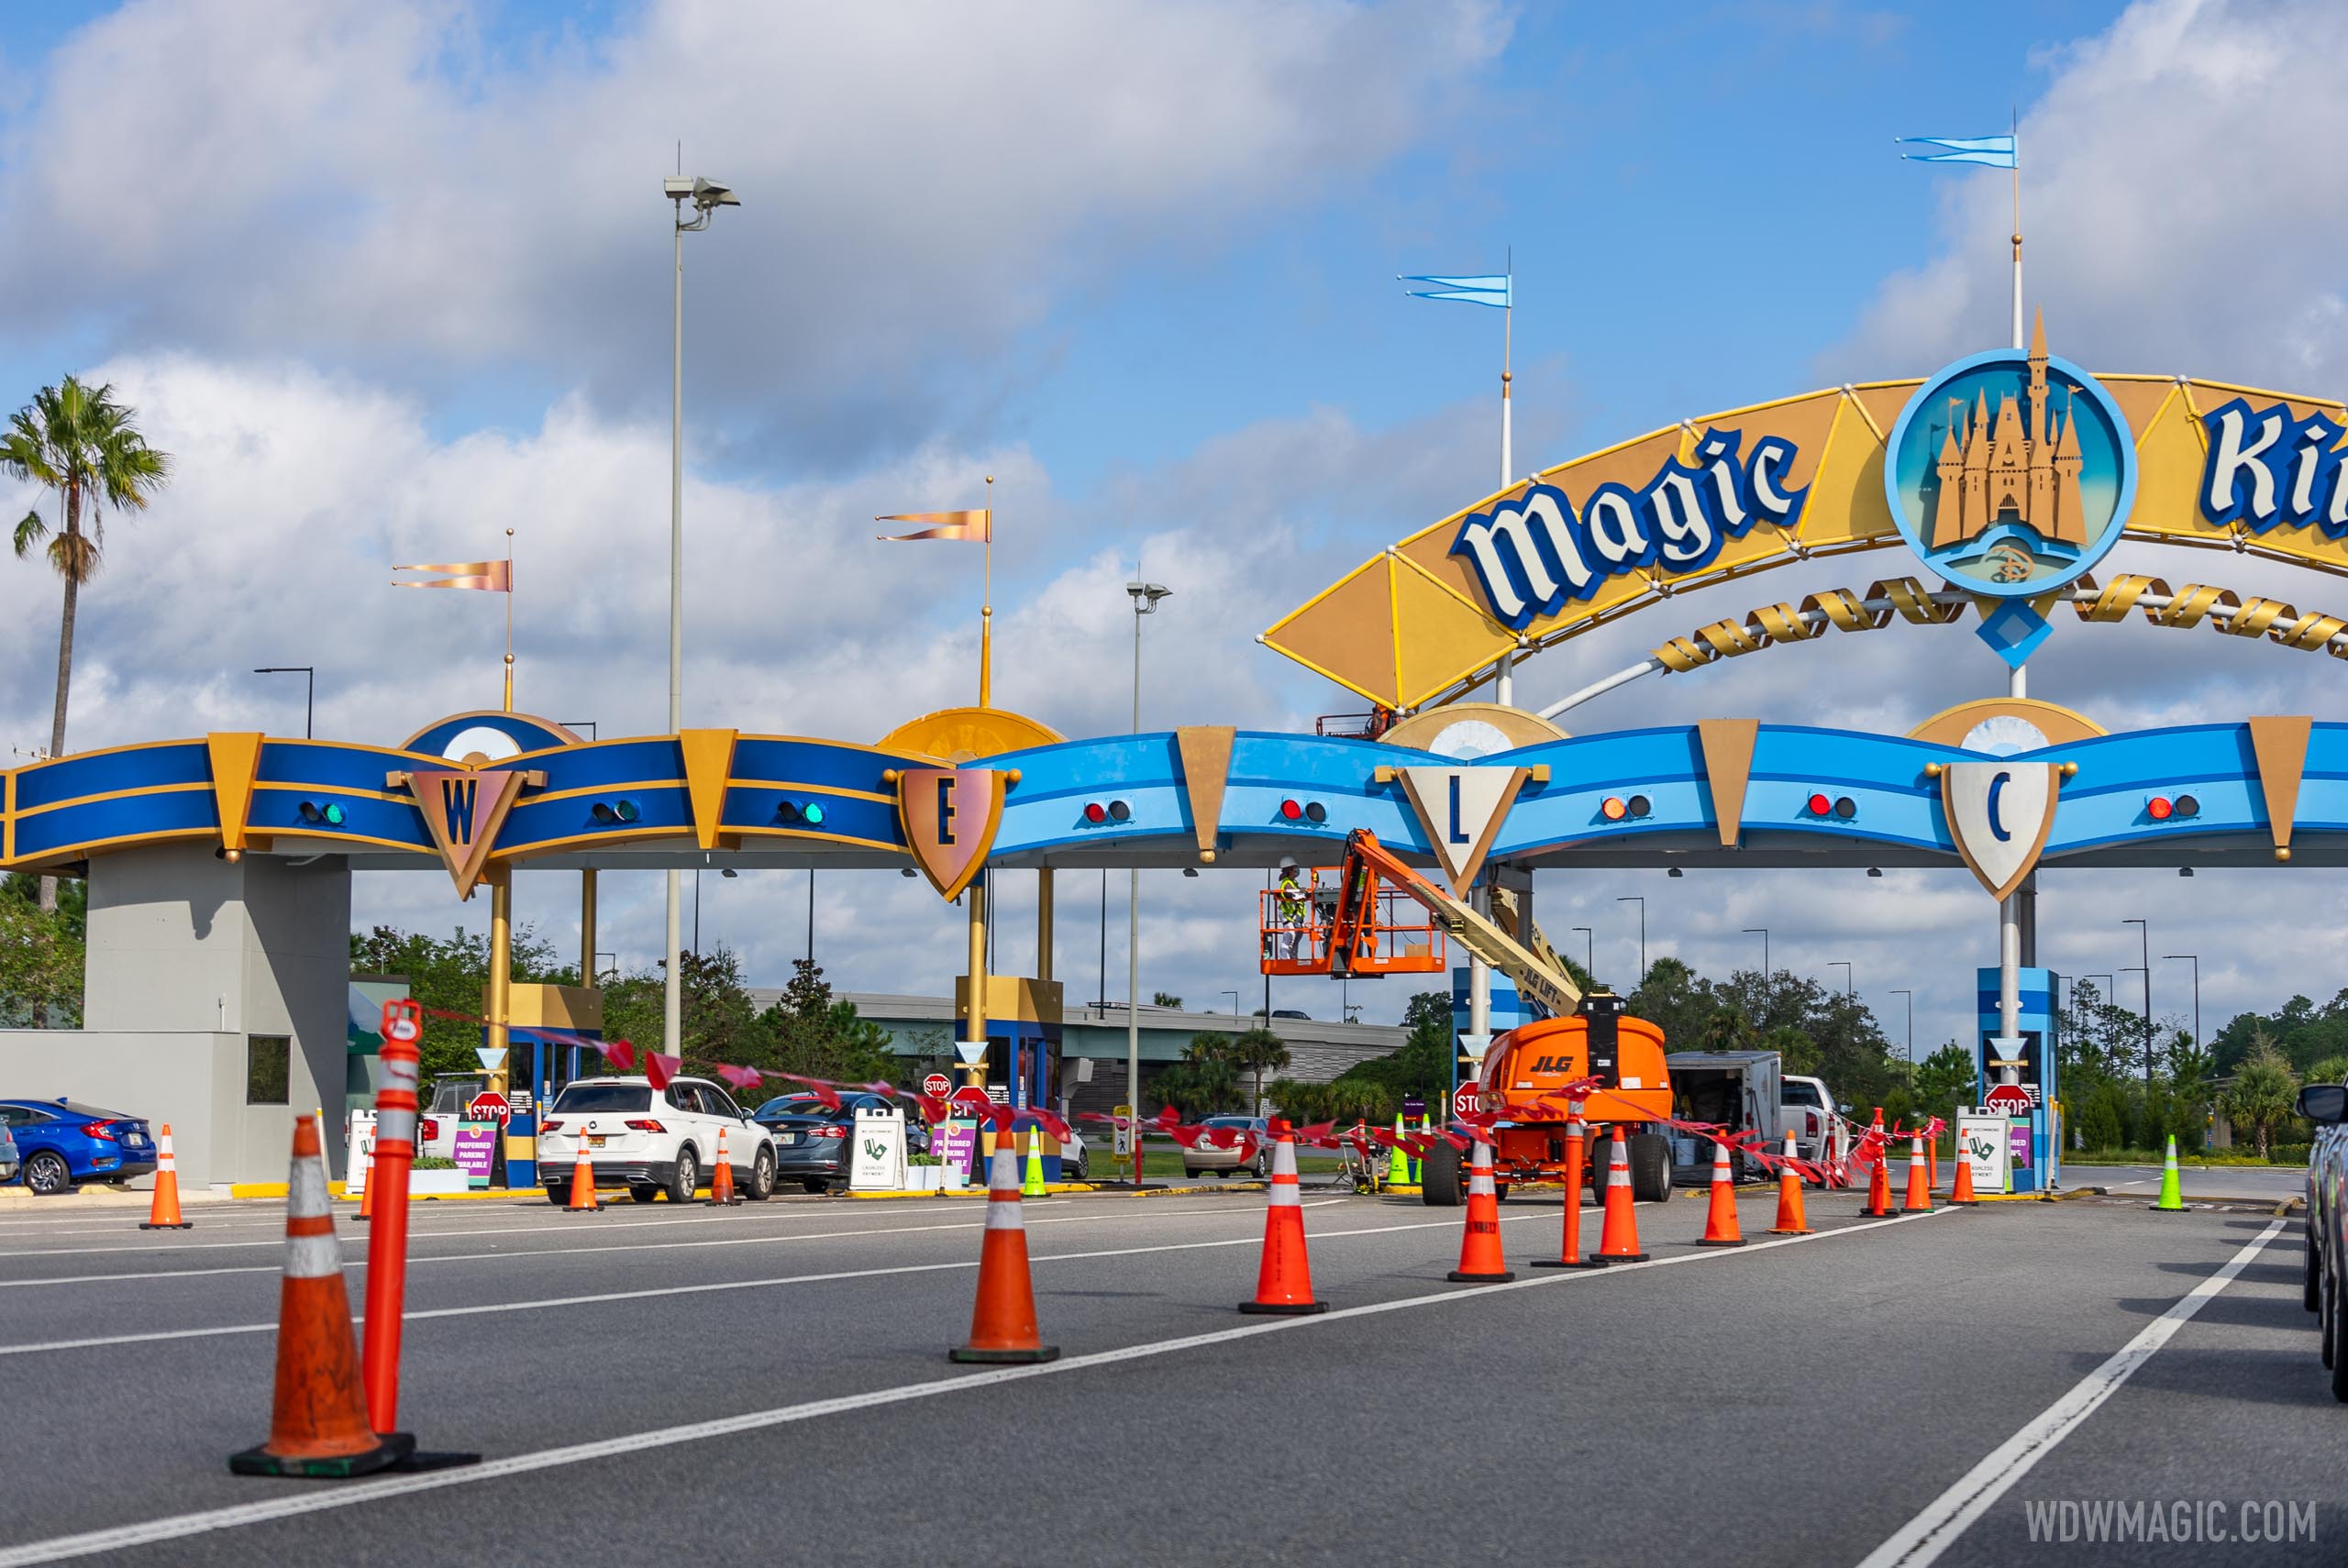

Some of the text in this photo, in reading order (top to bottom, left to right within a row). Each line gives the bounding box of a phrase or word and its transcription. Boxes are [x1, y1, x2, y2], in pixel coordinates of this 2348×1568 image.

[1462, 439, 1794, 618] Magic
[440, 771, 2011, 846] W E L C
[1523, 967, 1558, 1003] JLG LIFT
[1529, 1055, 1574, 1072] JLG
[925, 1080, 949, 1092] STOP
[472, 1104, 508, 1121] STOP
[1988, 1099, 2029, 1116] STOP
[456, 1141, 492, 1149] PREFERRED
[934, 1139, 971, 1147] PRFERRED
[459, 1151, 486, 1159] PARKING
